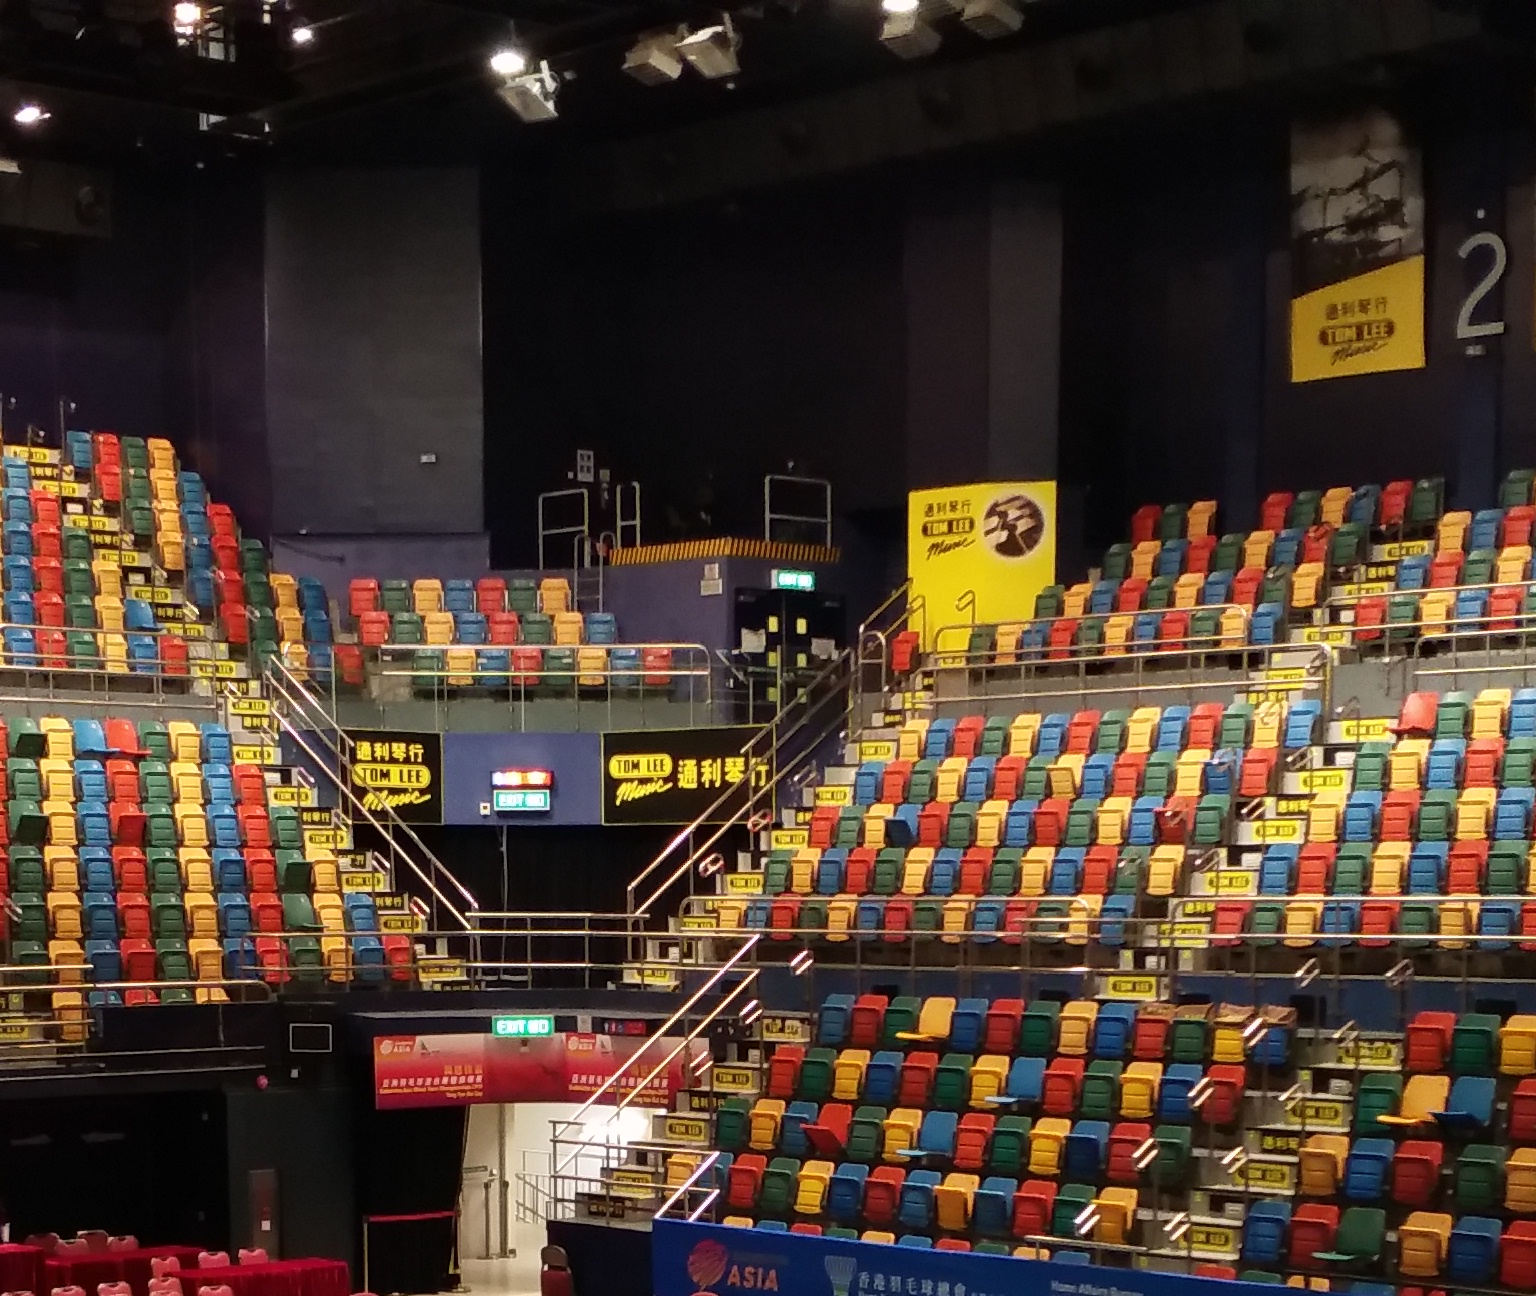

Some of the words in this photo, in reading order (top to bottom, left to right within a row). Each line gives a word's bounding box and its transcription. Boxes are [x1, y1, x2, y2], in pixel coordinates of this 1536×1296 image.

[1457, 231, 1506, 339] 2
[1328, 325, 1355, 345] TOM
[1364, 323, 1389, 342] LEE
[926, 522, 948, 536] TOM
[953, 520, 971, 533] LEE
[356, 742, 425, 763] 通利琴行
[362, 768, 392, 785] TOM
[400, 766, 426, 783] LEE
[616, 760, 642, 775] TOM
[647, 759, 670, 773] LEE
[677, 757, 771, 790] 通利琴行
[728, 1265, 778, 1291] ASIA
